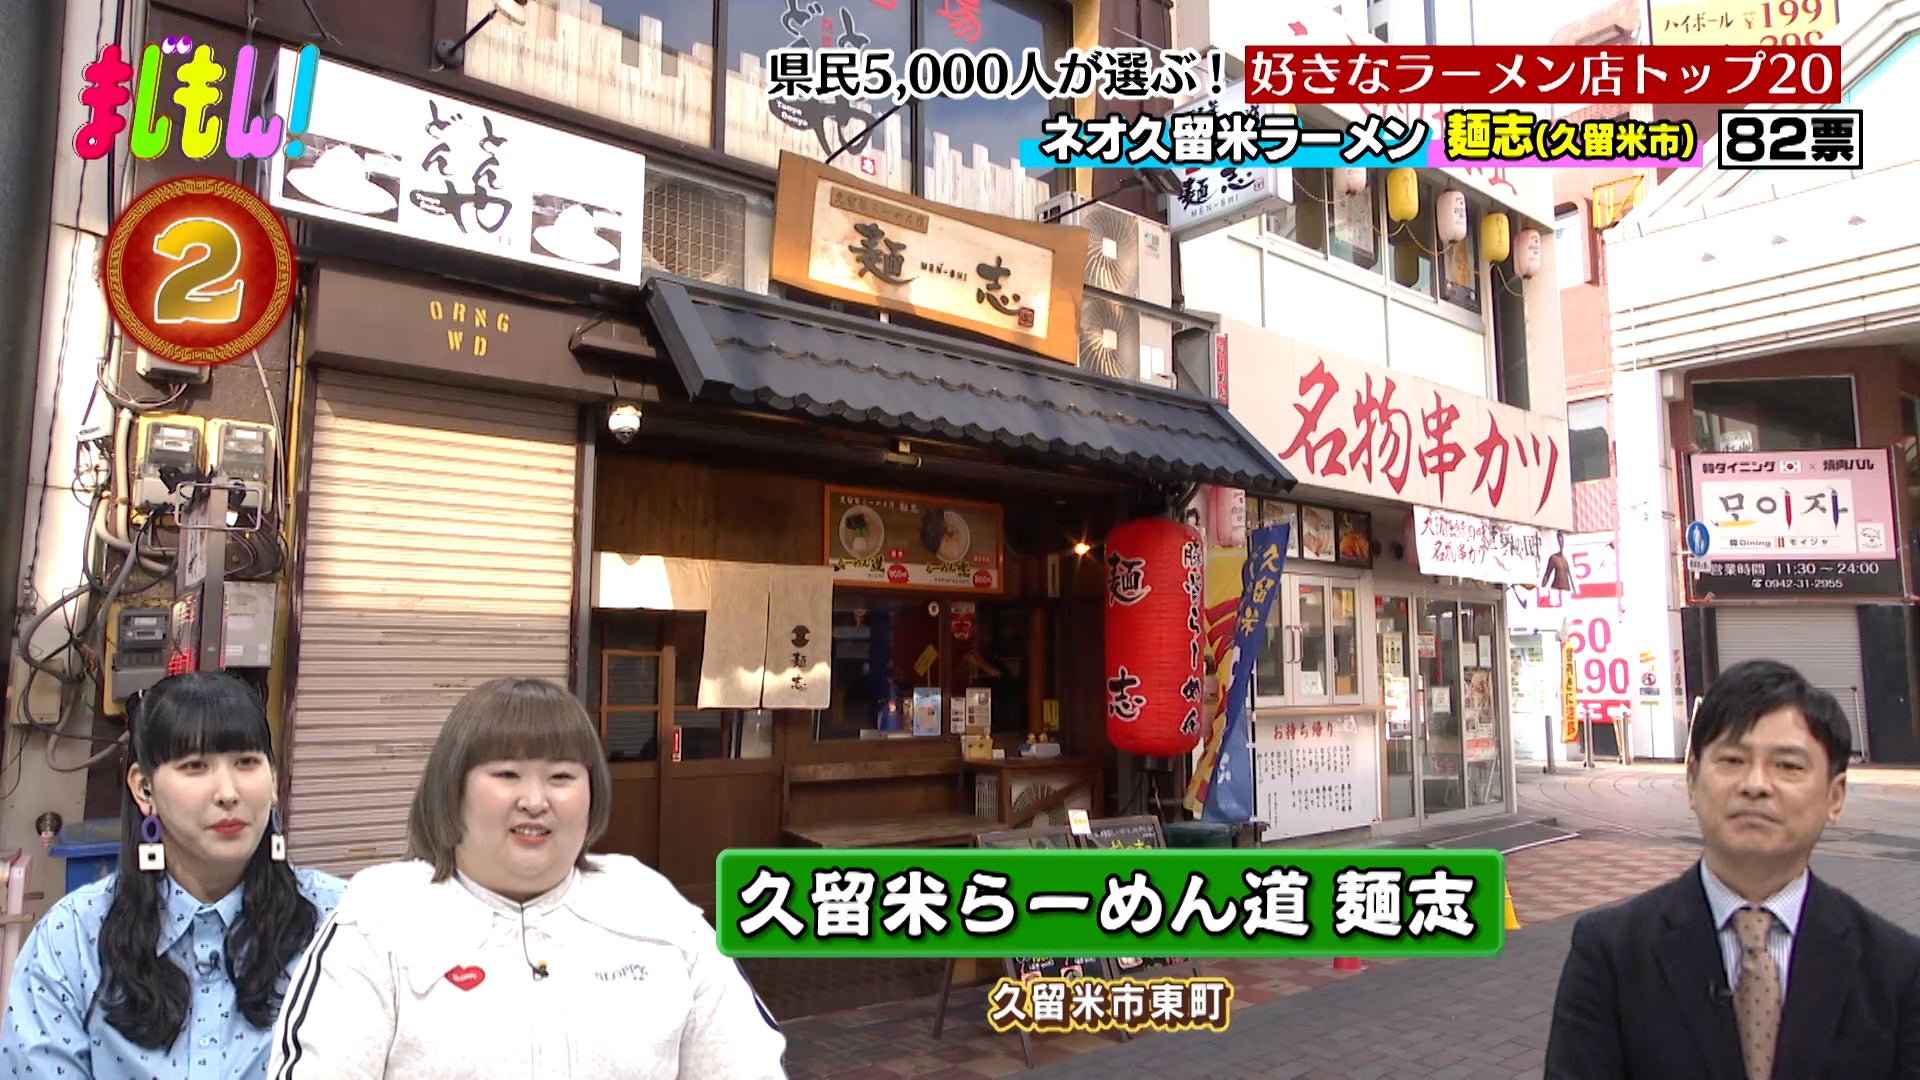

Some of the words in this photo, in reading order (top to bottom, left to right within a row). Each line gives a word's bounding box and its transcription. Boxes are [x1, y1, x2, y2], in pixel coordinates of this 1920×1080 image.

[1664, 11, 1734, 34] ハイボール
[429, 300, 510, 333] ORNG
[447, 329, 488, 356] WD
[1278, 356, 1558, 515] 名物串カツ
[1710, 562, 1766, 577] 営業時間
[1775, 562, 1816, 576] 11:30
[1837, 560, 1880, 575] 24:00
[1273, 720, 1334, 740] お持ち帰り
